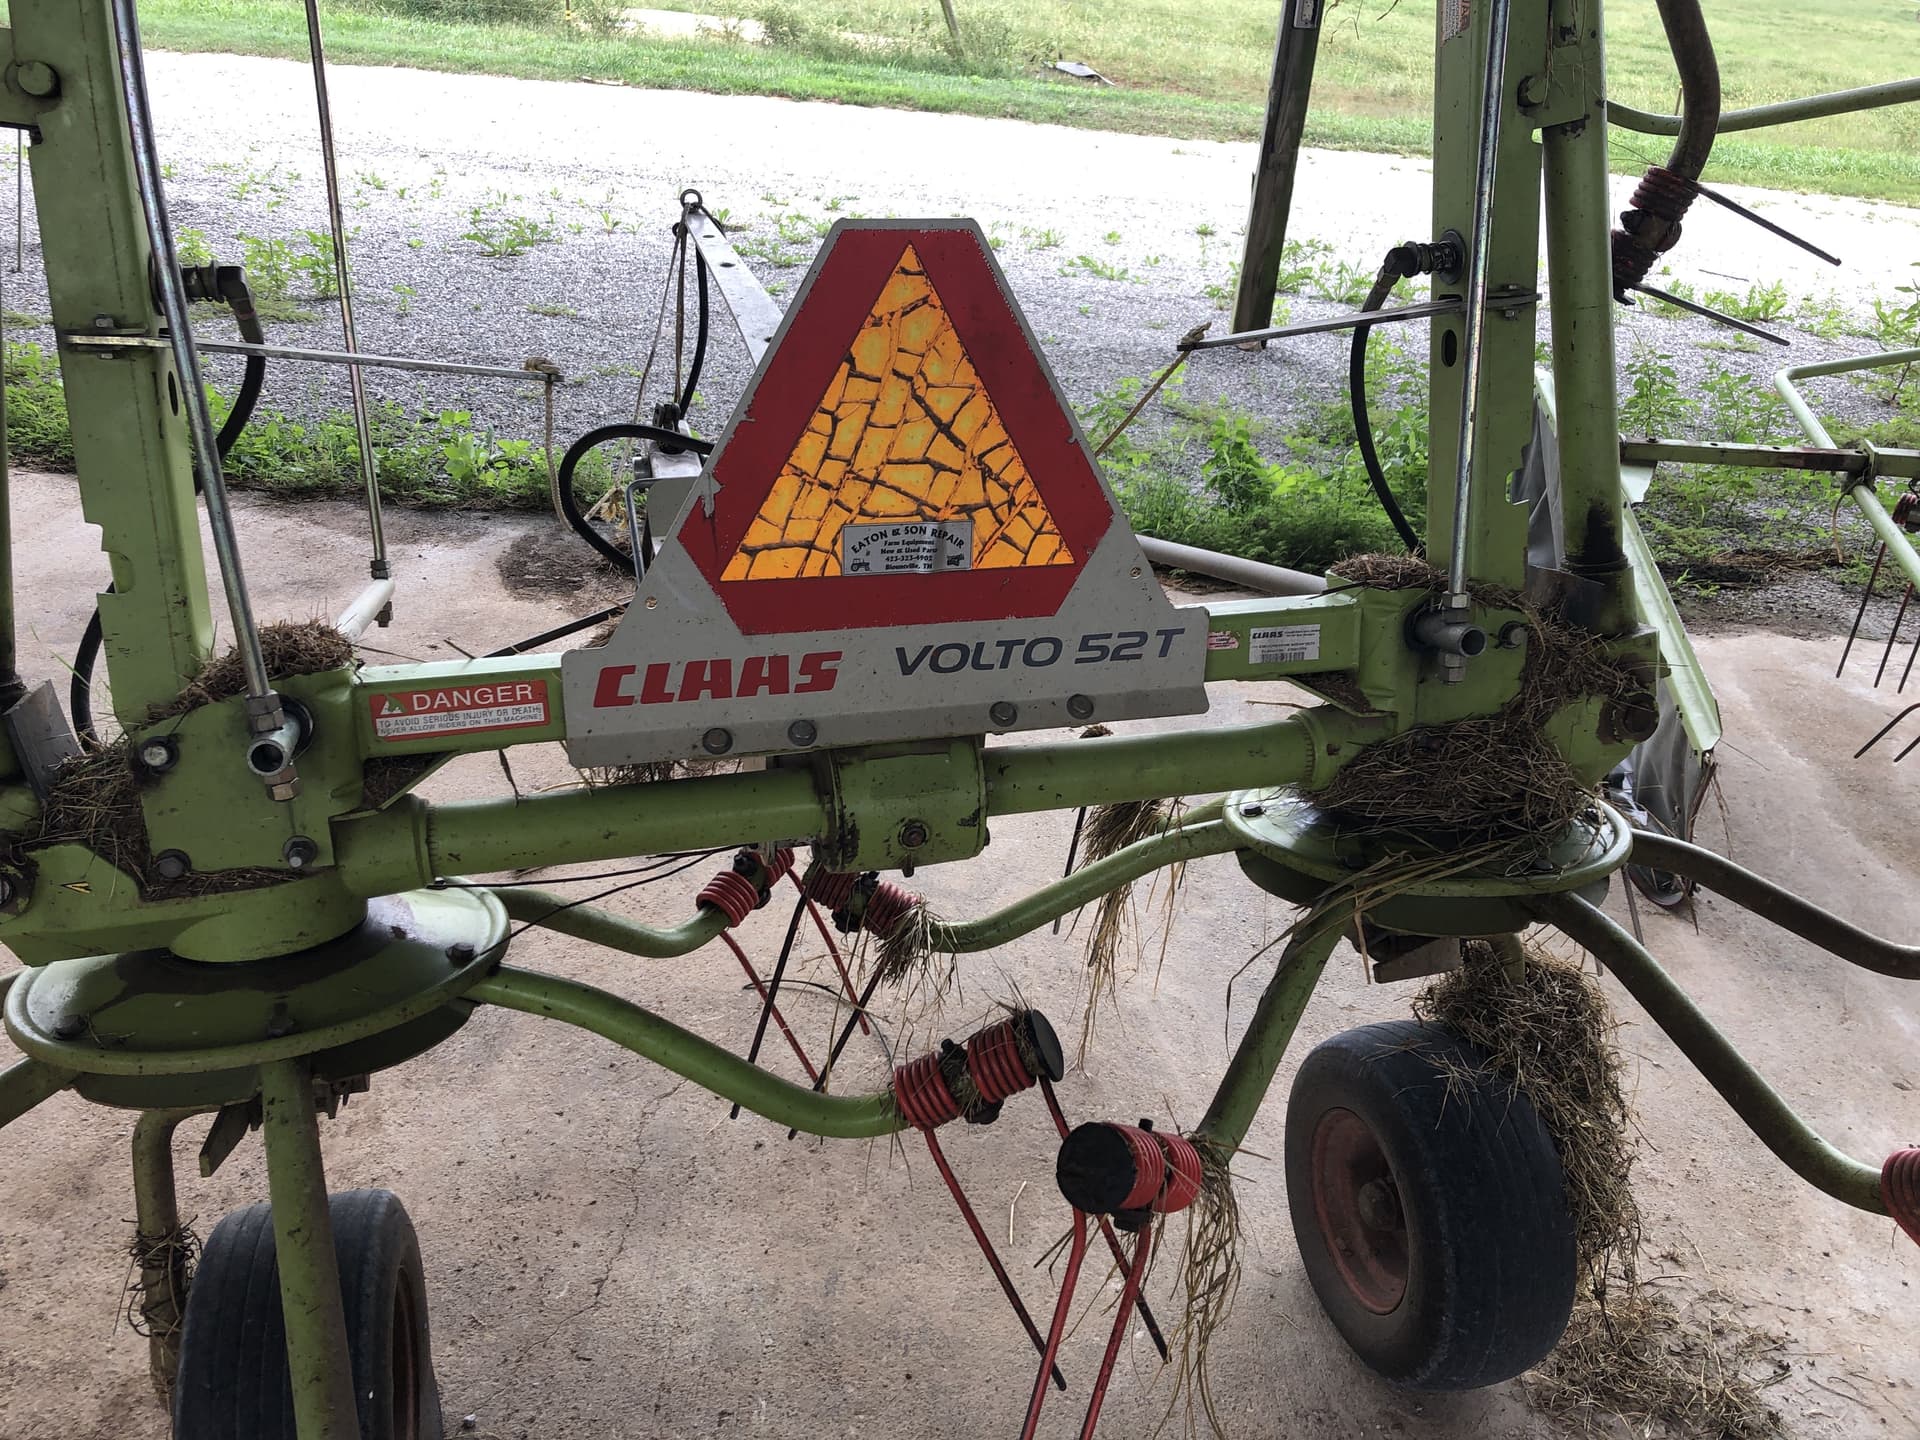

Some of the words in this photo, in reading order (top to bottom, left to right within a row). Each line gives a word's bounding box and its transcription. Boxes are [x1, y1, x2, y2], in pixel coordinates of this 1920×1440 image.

[851, 530, 888, 554] EATON
[904, 525, 927, 535] SON
[930, 528, 965, 549] REPAIR
[902, 539, 934, 547] Equipment
[1252, 630, 1284, 640] CLAAS
[593, 651, 843, 708] CLAAS
[895, 636, 1063, 676] VOLTO
[412, 684, 533, 711] DANGER
[378, 726, 408, 735] NEVER
[409, 724, 436, 732] ALLOW
[438, 720, 467, 729] RIDERS
[484, 717, 501, 725] THIS
[379, 720, 392, 728] TO
[394, 717, 420, 727] AVOID
[423, 713, 460, 724] SERIOUS
[463, 710, 493, 720] INJURY
[496, 709, 509, 717] OR
